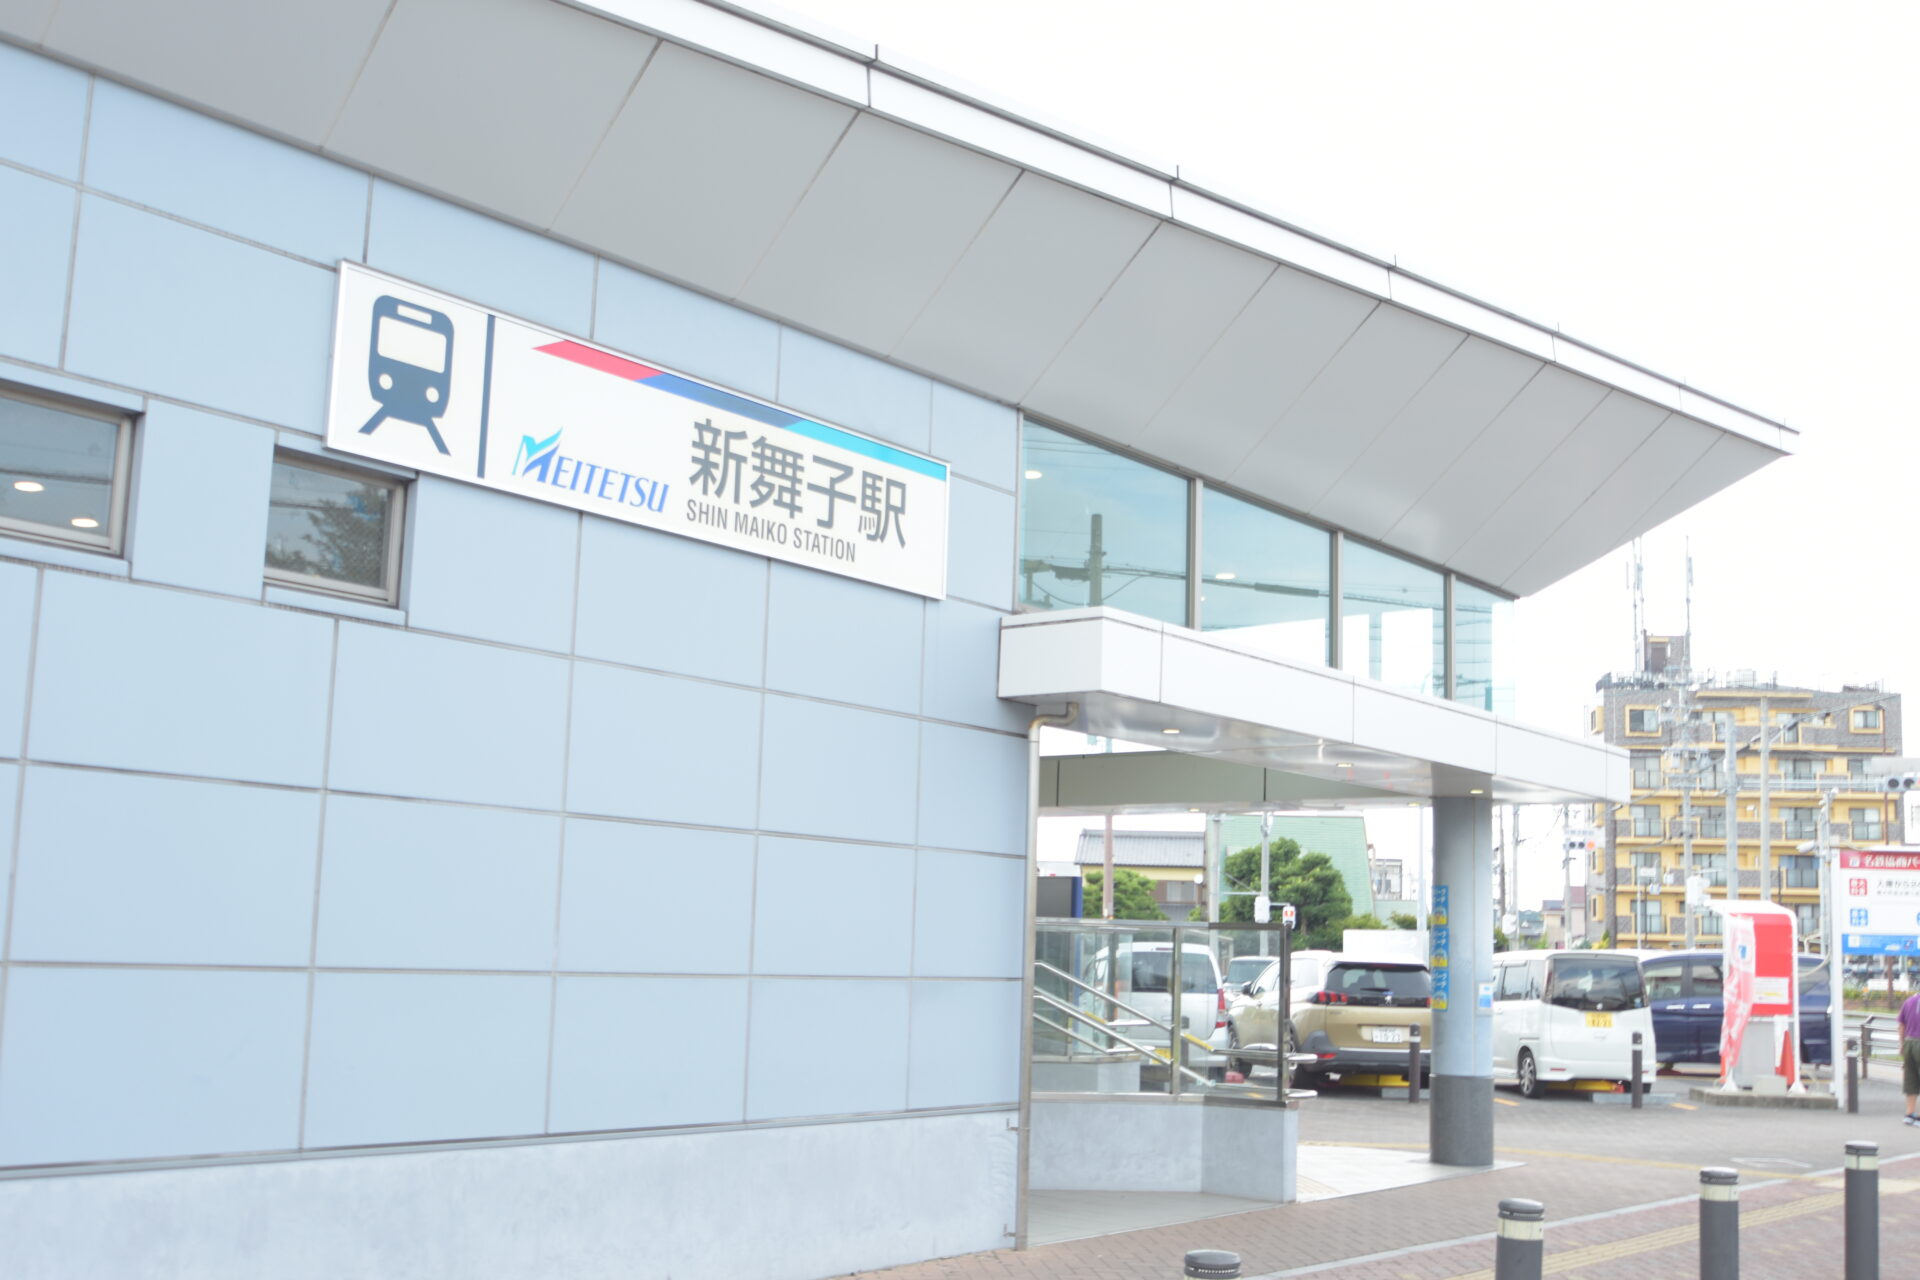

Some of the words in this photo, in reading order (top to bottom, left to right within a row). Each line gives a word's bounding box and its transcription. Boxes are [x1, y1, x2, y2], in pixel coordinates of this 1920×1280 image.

[511, 425, 670, 514] MEITETSU
[688, 418, 907, 549] 新舞子駅
[685, 499, 729, 531] SHIN
[733, 511, 788, 545] MAIKO
[792, 527, 857, 564] STATION
